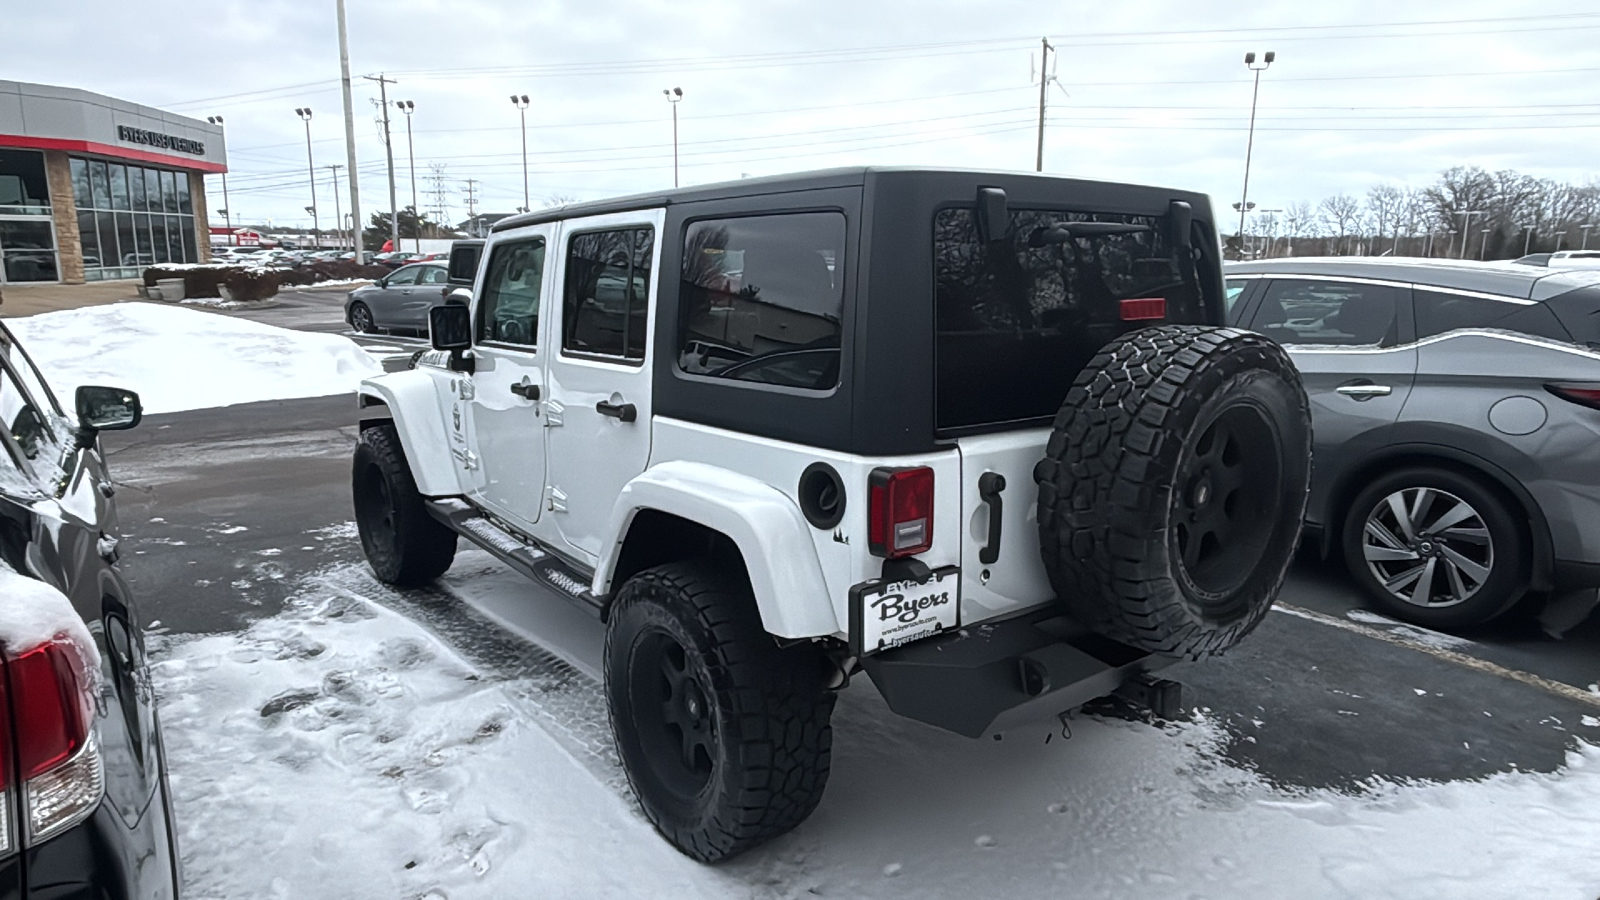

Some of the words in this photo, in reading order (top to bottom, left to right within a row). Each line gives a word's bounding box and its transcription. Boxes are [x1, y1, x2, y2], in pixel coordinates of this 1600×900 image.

[119, 125, 150, 145] BYERS
[151, 132, 171, 149] USED
[171, 136, 205, 155] VEHICLES
[870, 592, 949, 622] Byers
[881, 616, 937, 636] www.byersauto.com
